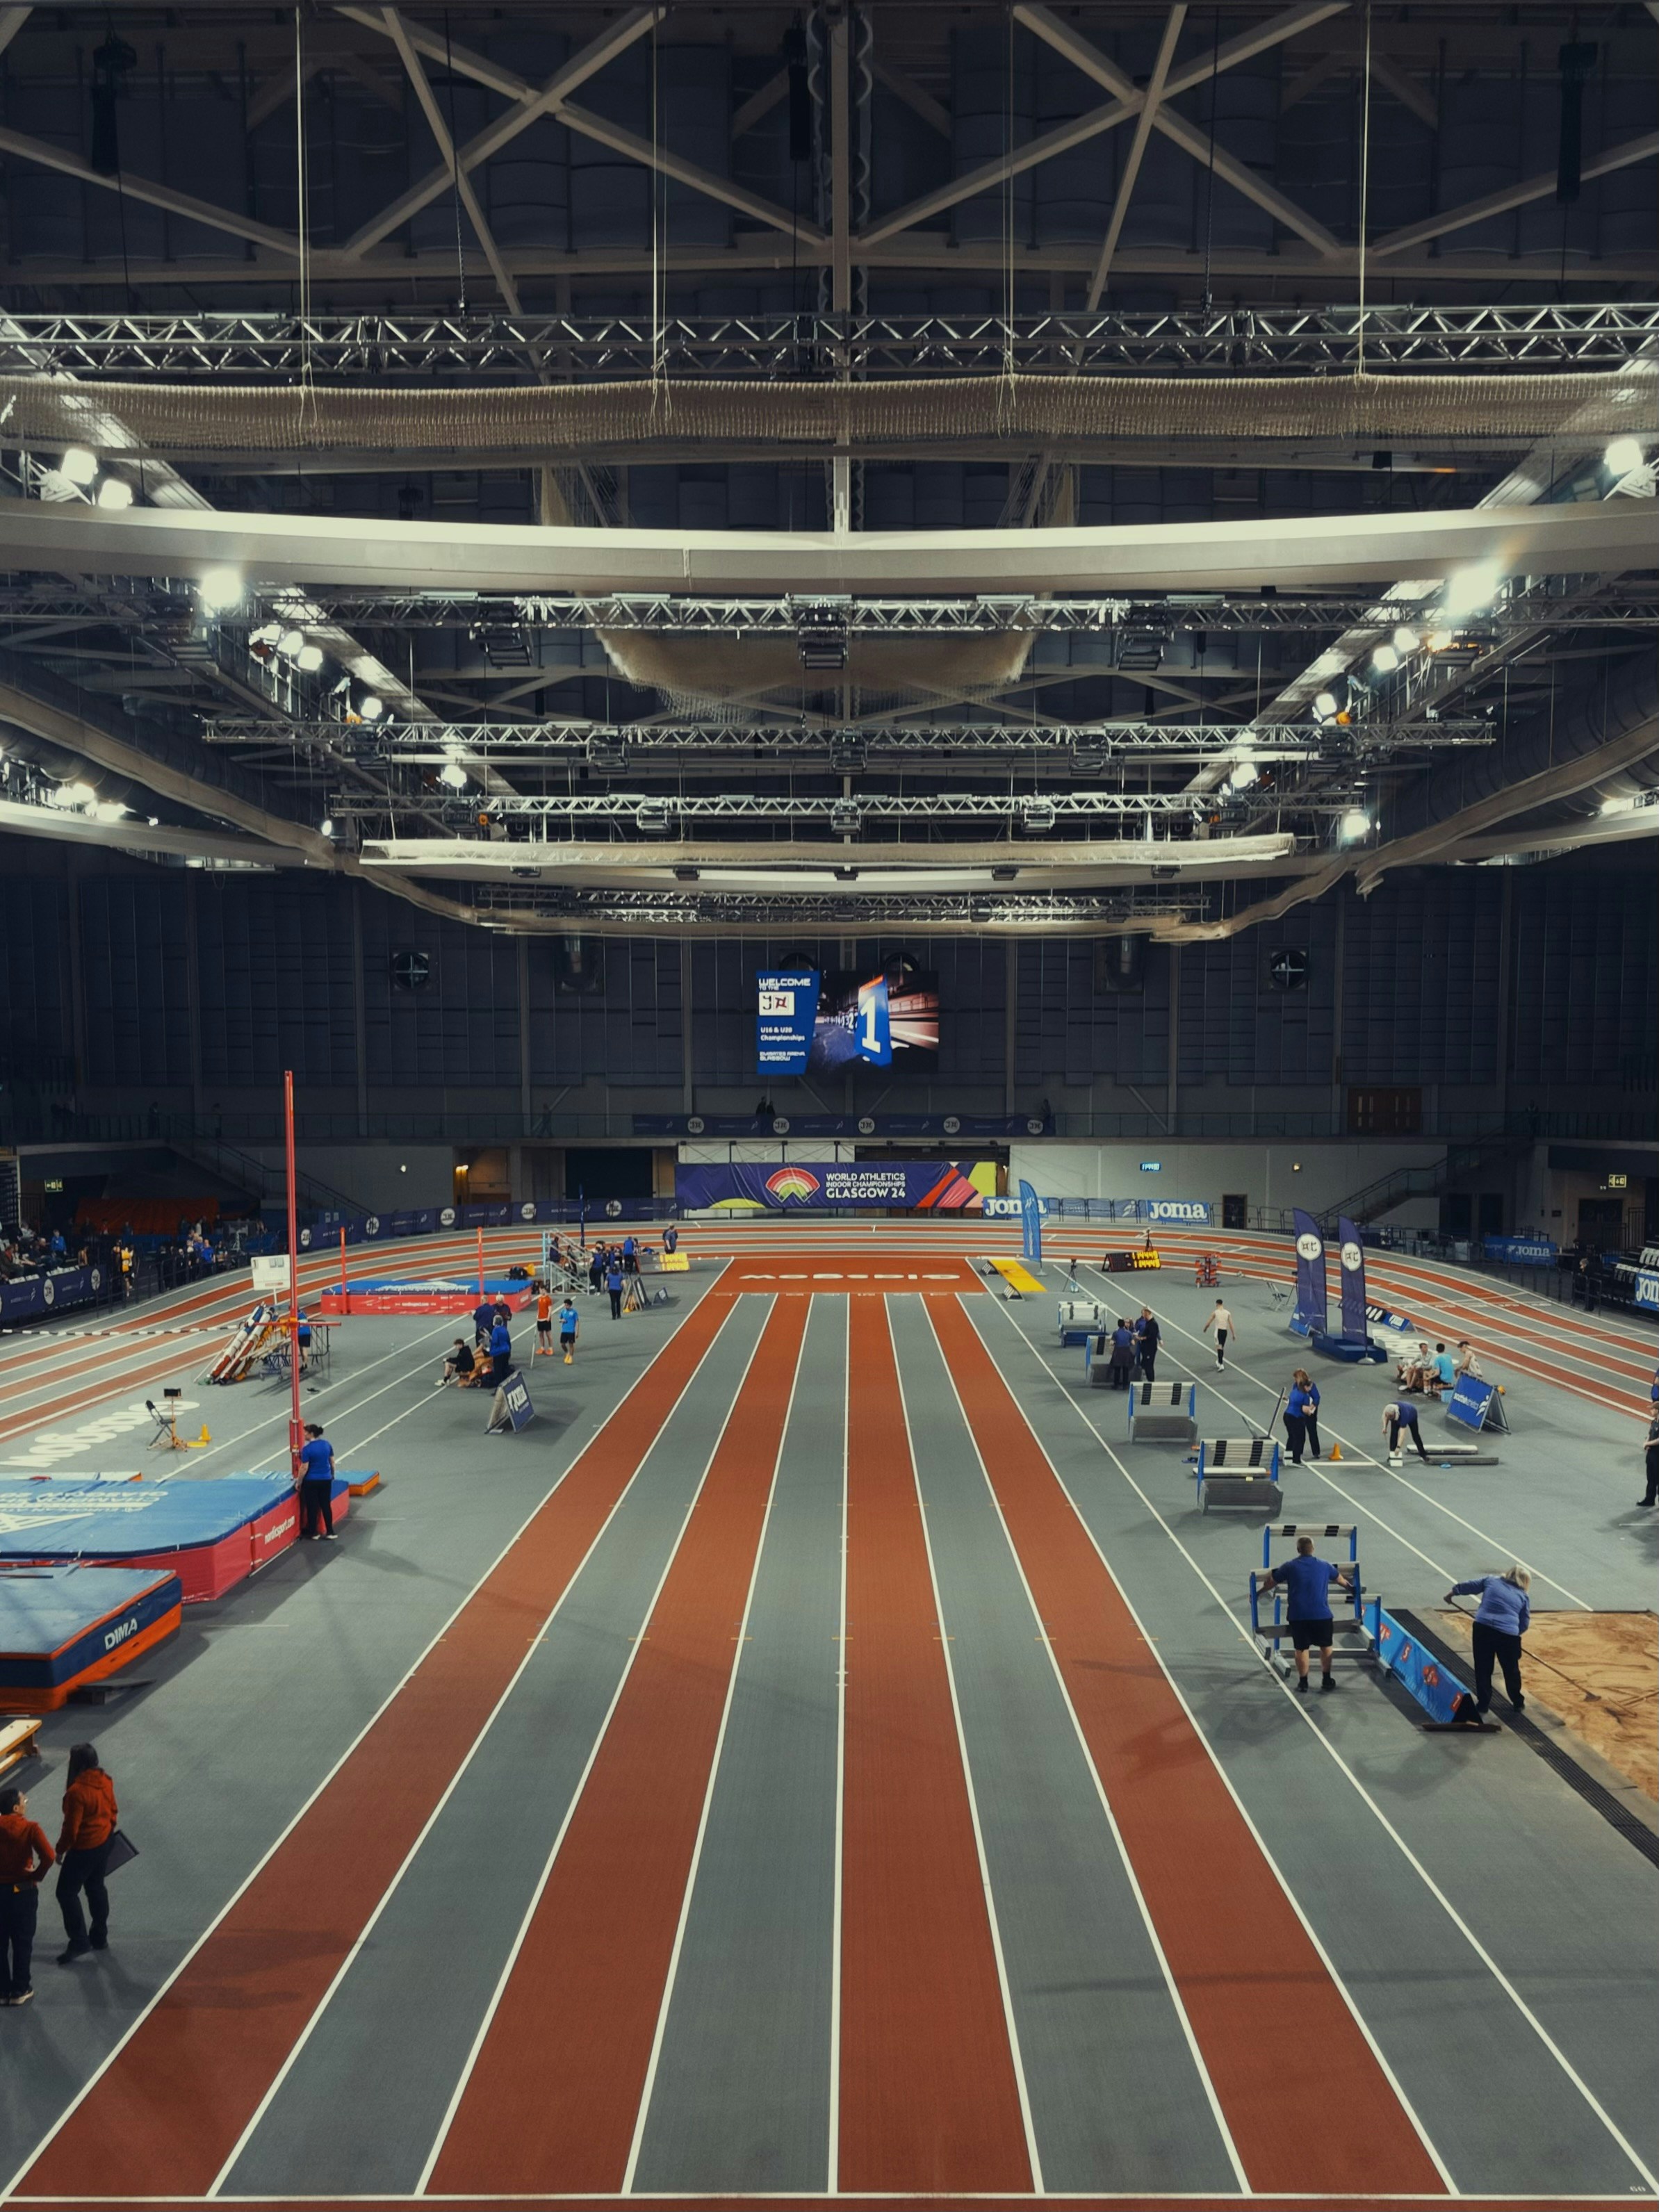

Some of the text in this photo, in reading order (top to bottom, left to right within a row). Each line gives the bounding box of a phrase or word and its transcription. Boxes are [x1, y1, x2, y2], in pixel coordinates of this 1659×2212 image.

[758, 978, 811, 986] WELCOME
[860, 996, 881, 1054] 1
[826, 1188, 906, 1199] GLASGOW 24
[104, 1617, 138, 1651] DIMA
